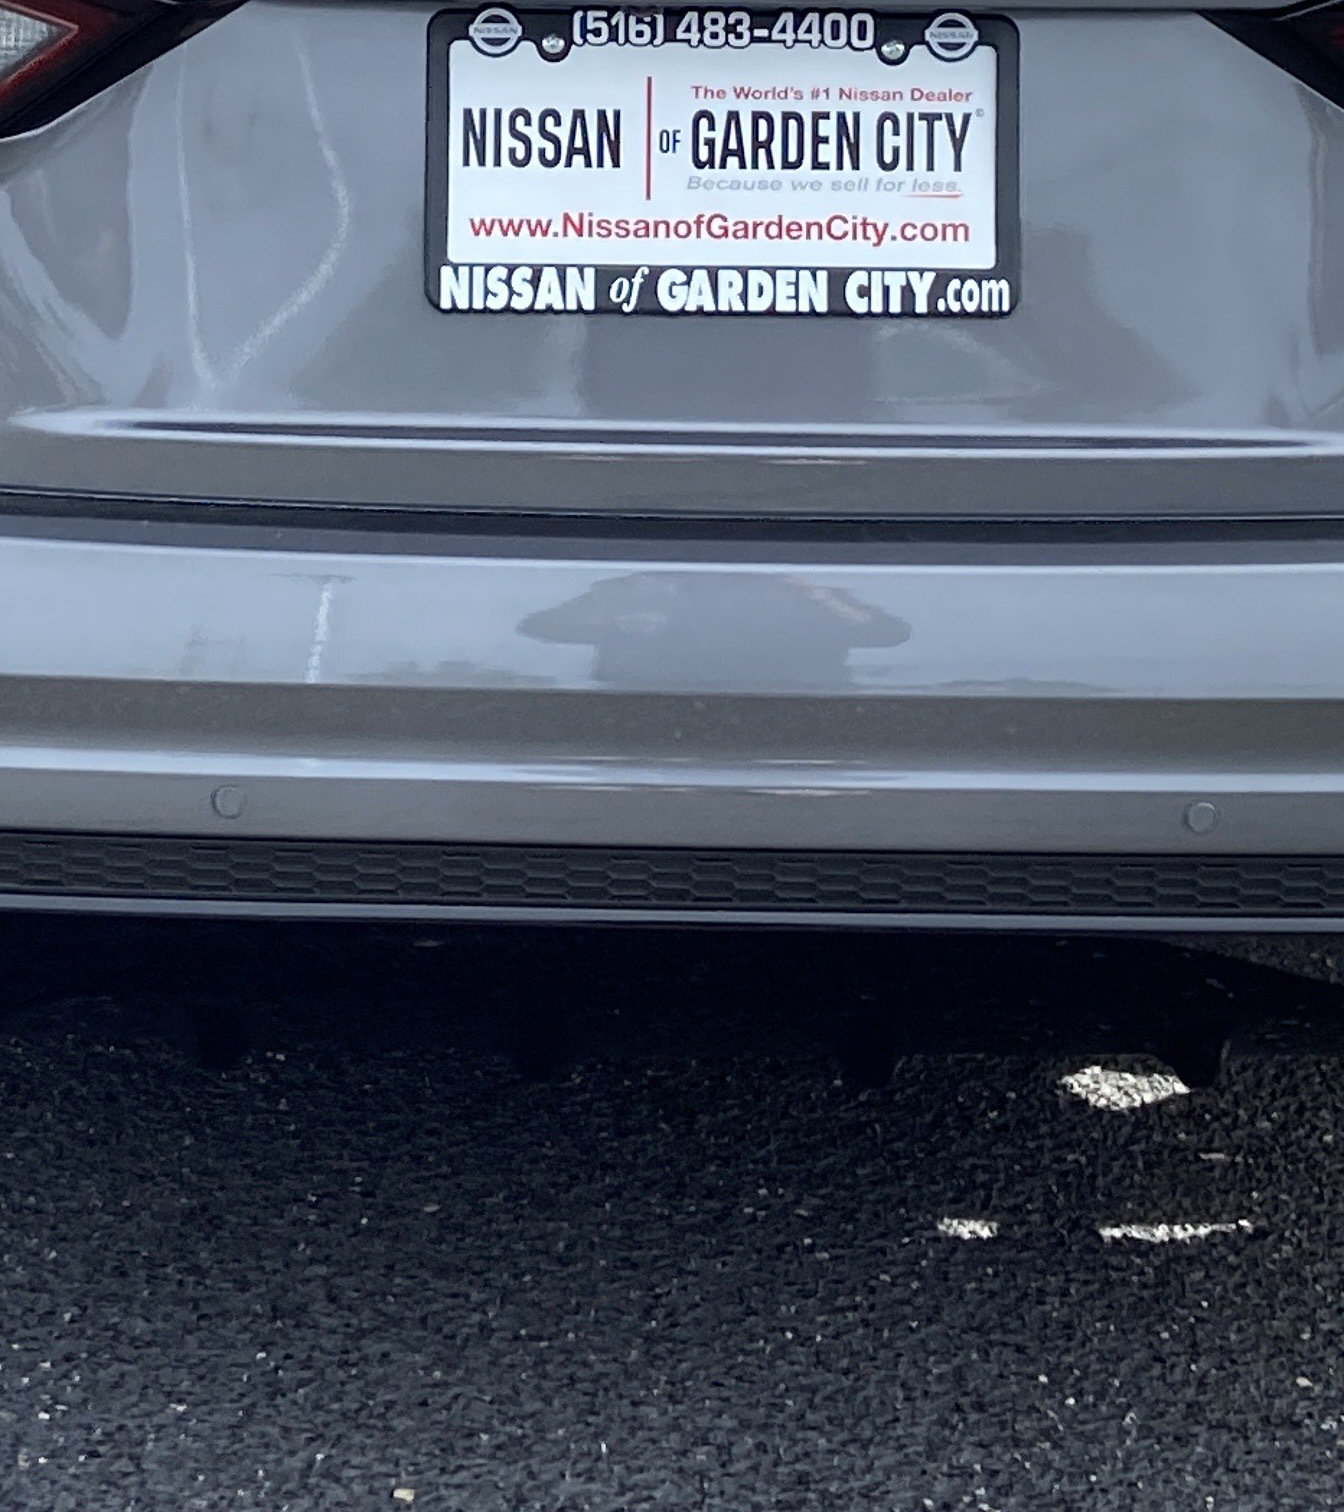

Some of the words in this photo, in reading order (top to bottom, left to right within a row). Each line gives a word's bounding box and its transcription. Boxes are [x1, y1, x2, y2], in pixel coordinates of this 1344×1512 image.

[573, 10, 664, 47] (516)
[676, 11, 876, 49] 483-4400
[691, 85, 727, 101] The
[732, 85, 803, 102] World's
[810, 86, 830, 101] #1
[839, 86, 904, 103] Nissan
[910, 87, 973, 104] Dealer
[462, 107, 621, 168] NISSAN
[659, 129, 681, 154] OF
[691, 109, 861, 171] GARDEN
[876, 111, 973, 173] CITY
[687, 175, 783, 192] Because
[795, 179, 822, 193] we
[831, 176, 869, 193] sell
[876, 177, 906, 194] for
[912, 177, 964, 194] less.
[469, 212, 970, 248] www.NissanofGardenCity.com
[439, 265, 596, 311] NISSAN
[609, 266, 649, 313] of
[656, 268, 829, 313] GARDEN
[845, 270, 1011, 314] CITY.com
